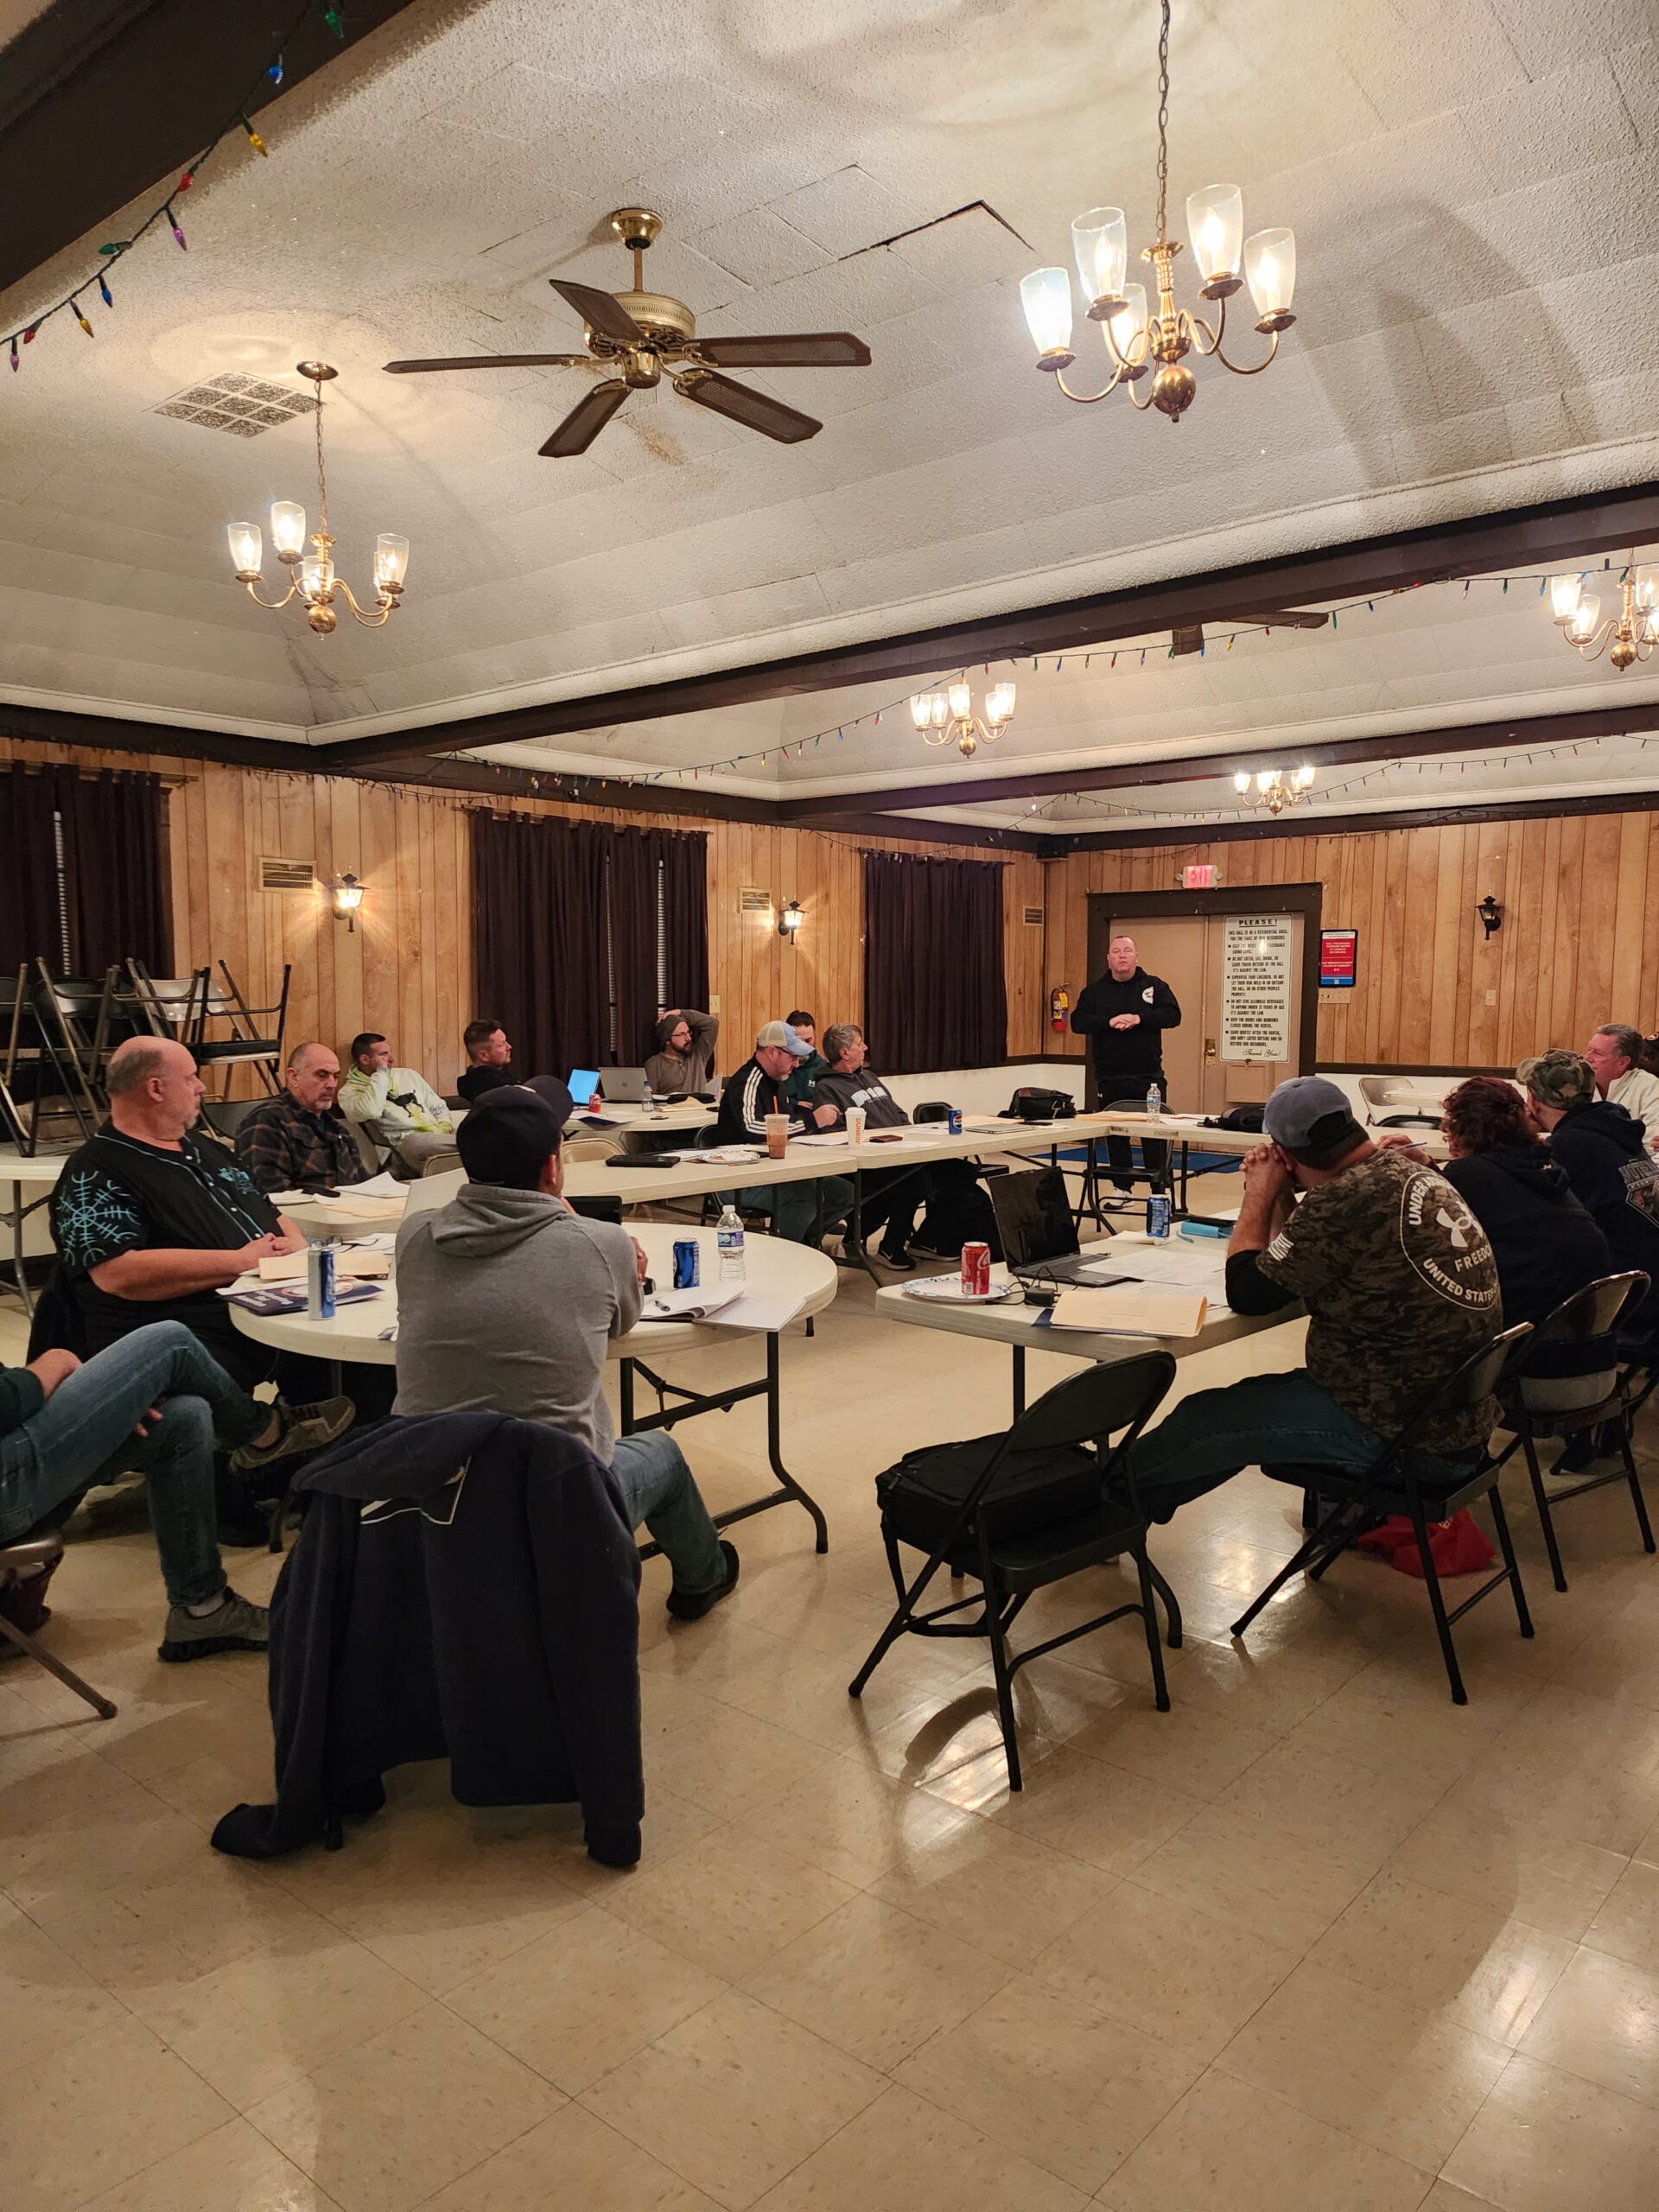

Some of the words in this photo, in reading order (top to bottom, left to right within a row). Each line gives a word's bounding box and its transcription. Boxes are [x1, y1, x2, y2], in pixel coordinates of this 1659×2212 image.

[1188, 865, 1212, 886] EXIT
[1264, 1049, 1281, 1058] You!
[1408, 1180, 1430, 1226] UNDER
[1423, 1258, 1464, 1296] UNITED
